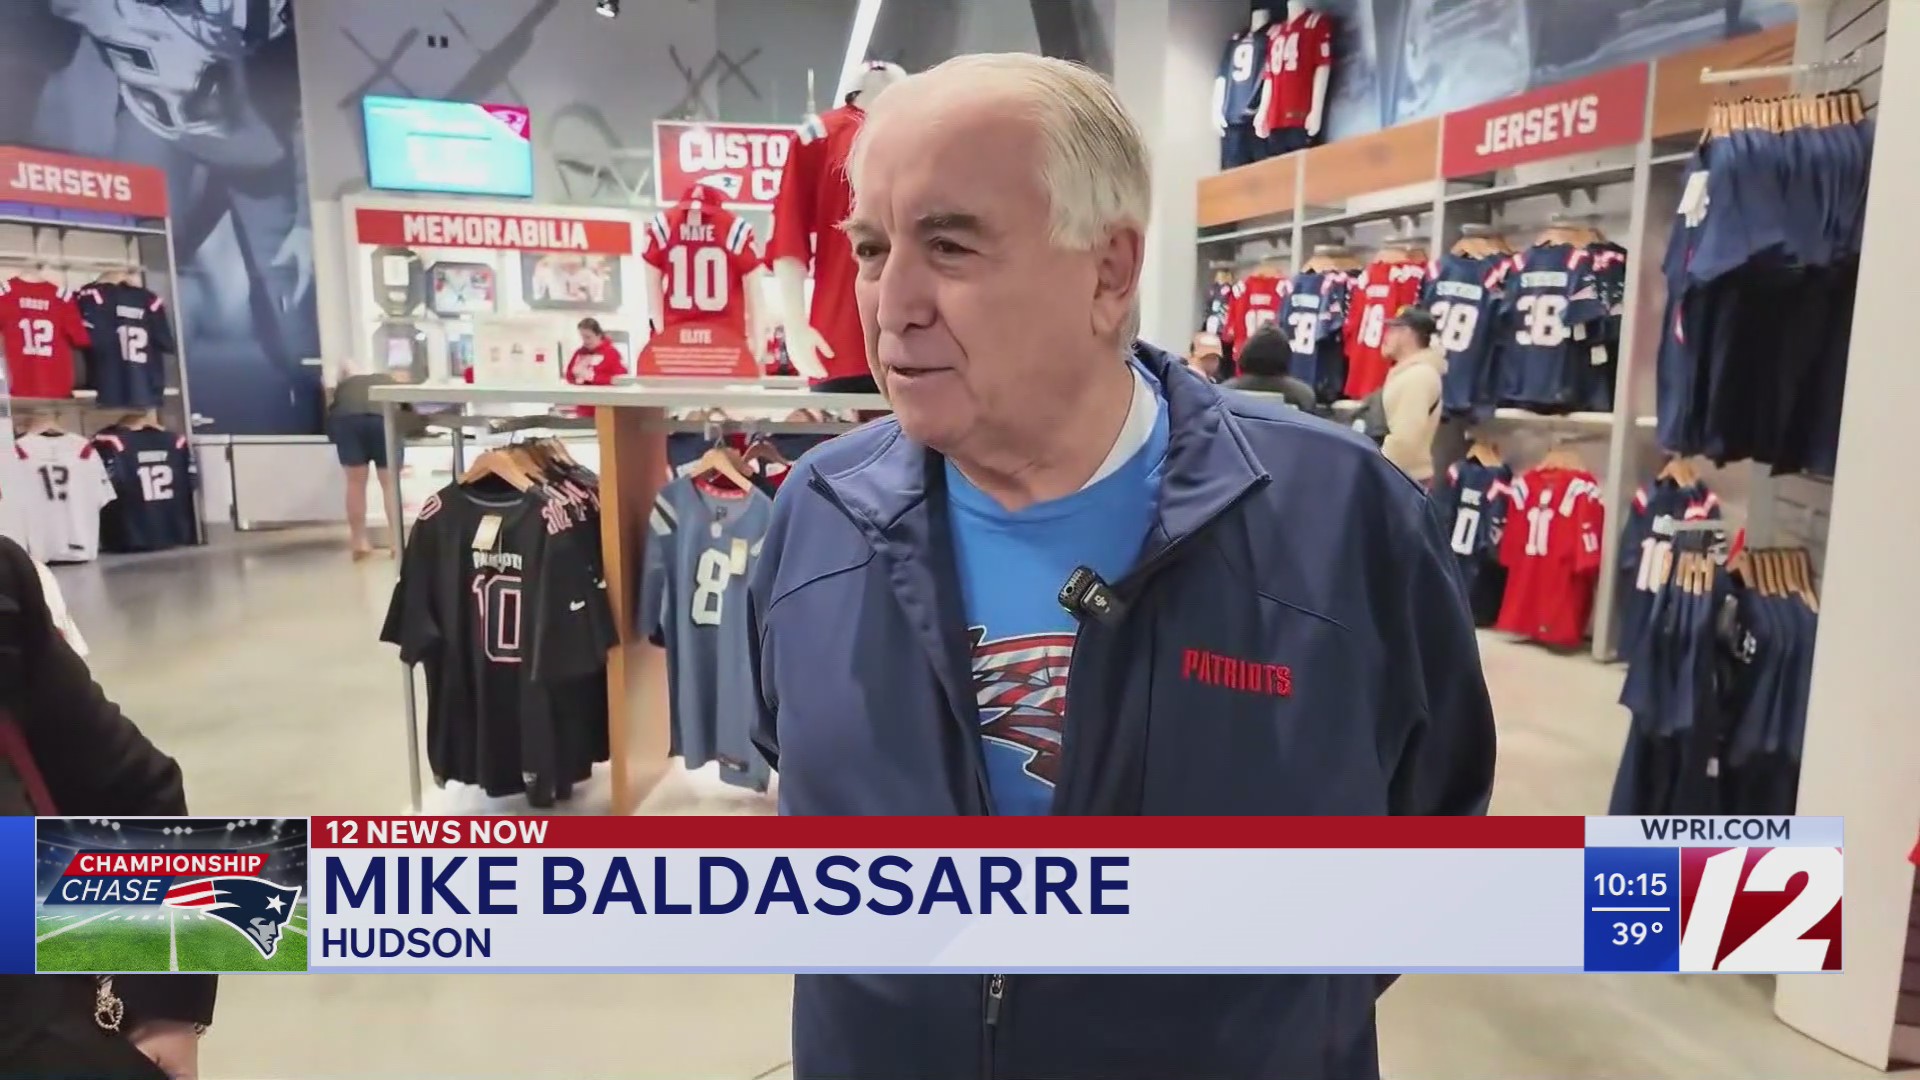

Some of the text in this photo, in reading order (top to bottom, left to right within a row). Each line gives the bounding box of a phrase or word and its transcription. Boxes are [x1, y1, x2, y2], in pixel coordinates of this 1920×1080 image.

[1232, 42, 1254, 82] 9
[1271, 31, 1299, 75] 84
[1476, 96, 1599, 156] JERSEYS
[10, 161, 132, 201] JERSEYS
[403, 214, 589, 249] MEMORABILIA
[668, 245, 728, 312] 10
[18, 318, 54, 357] 12
[1515, 294, 1569, 346] 38
[116, 324, 148, 364] 12
[38, 464, 69, 501] 12
[137, 464, 174, 501] 12
[692, 547, 731, 625] 8
[1180, 648, 1294, 697] PATRIOTS
